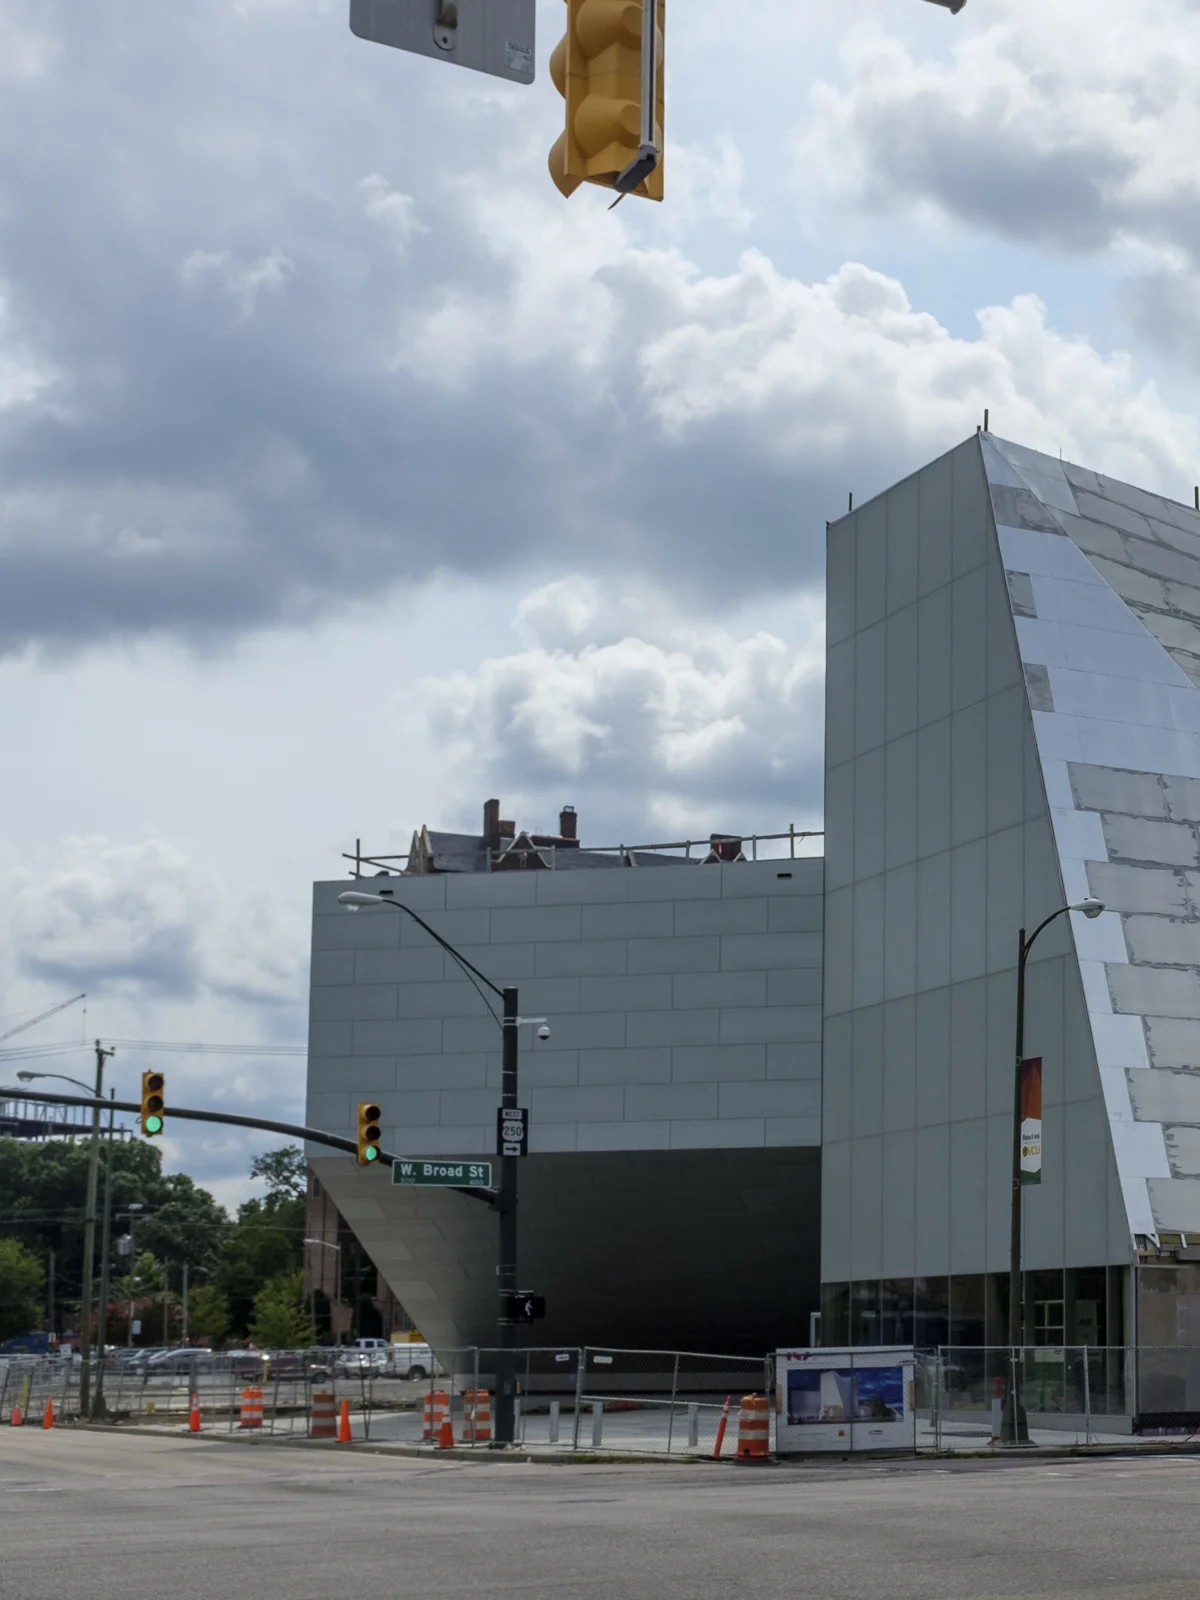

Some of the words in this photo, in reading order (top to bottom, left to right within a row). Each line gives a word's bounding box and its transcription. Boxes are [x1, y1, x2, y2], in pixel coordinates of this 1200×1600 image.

[504, 1126, 522, 1136] 250
[400, 1163, 416, 1176] W.
[423, 1163, 463, 1177] Broad
[468, 1165, 484, 1178] St
